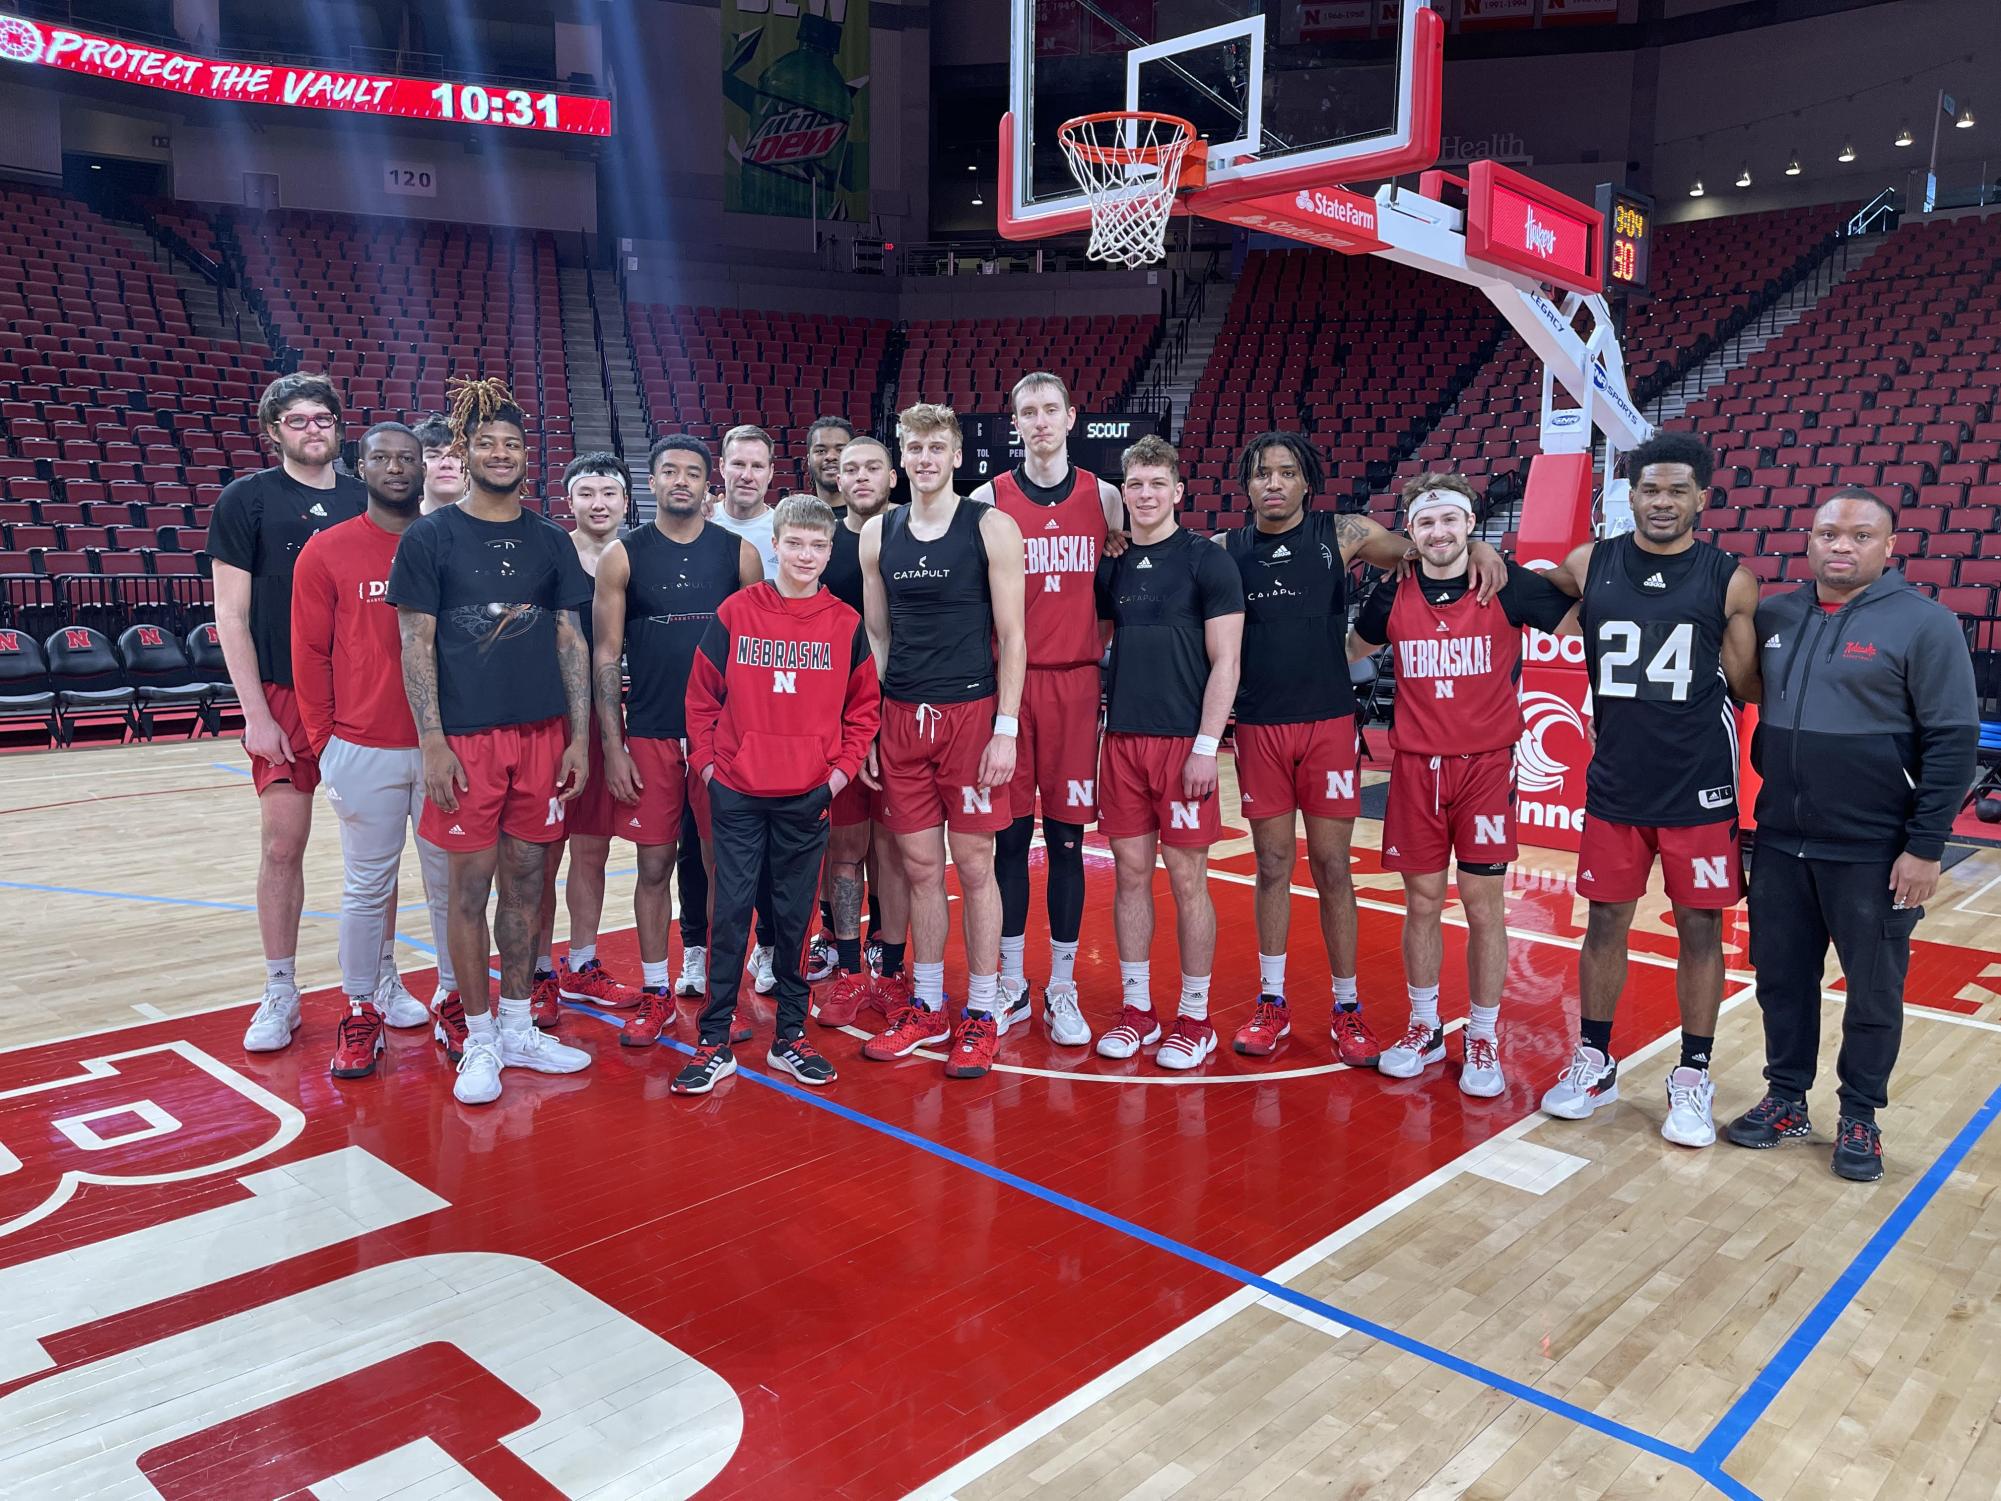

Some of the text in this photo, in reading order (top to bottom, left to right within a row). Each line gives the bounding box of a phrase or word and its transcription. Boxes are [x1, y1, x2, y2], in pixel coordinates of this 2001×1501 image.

[45, 31, 558, 128] PROTECT THE VAULT 10:31
[1441, 133, 1526, 160] Health
[389, 168, 431, 189] 120
[1613, 240, 1634, 281] 30
[1530, 290, 1565, 333] LEGACY
[1607, 385, 1638, 425] SPORTS
[1087, 422, 1130, 438] SCOUT
[977, 449, 990, 458] TOL
[893, 569, 950, 580] CATAPULT
[1044, 575, 1061, 592] N
[65, 630, 91, 648] N
[139, 628, 163, 645] N
[737, 636, 832, 670] NEBRASKA
[1399, 636, 1485, 678] NEBRASKA
[1598, 621, 1693, 700] 24
[772, 671, 797, 693] N
[1435, 680, 1454, 699] N
[1067, 779, 1094, 806] N
[1326, 770, 1354, 799] N
[962, 786, 993, 813] N
[1170, 801, 1199, 829] N
[1474, 815, 1506, 844] N
[1691, 856, 1729, 888] N
